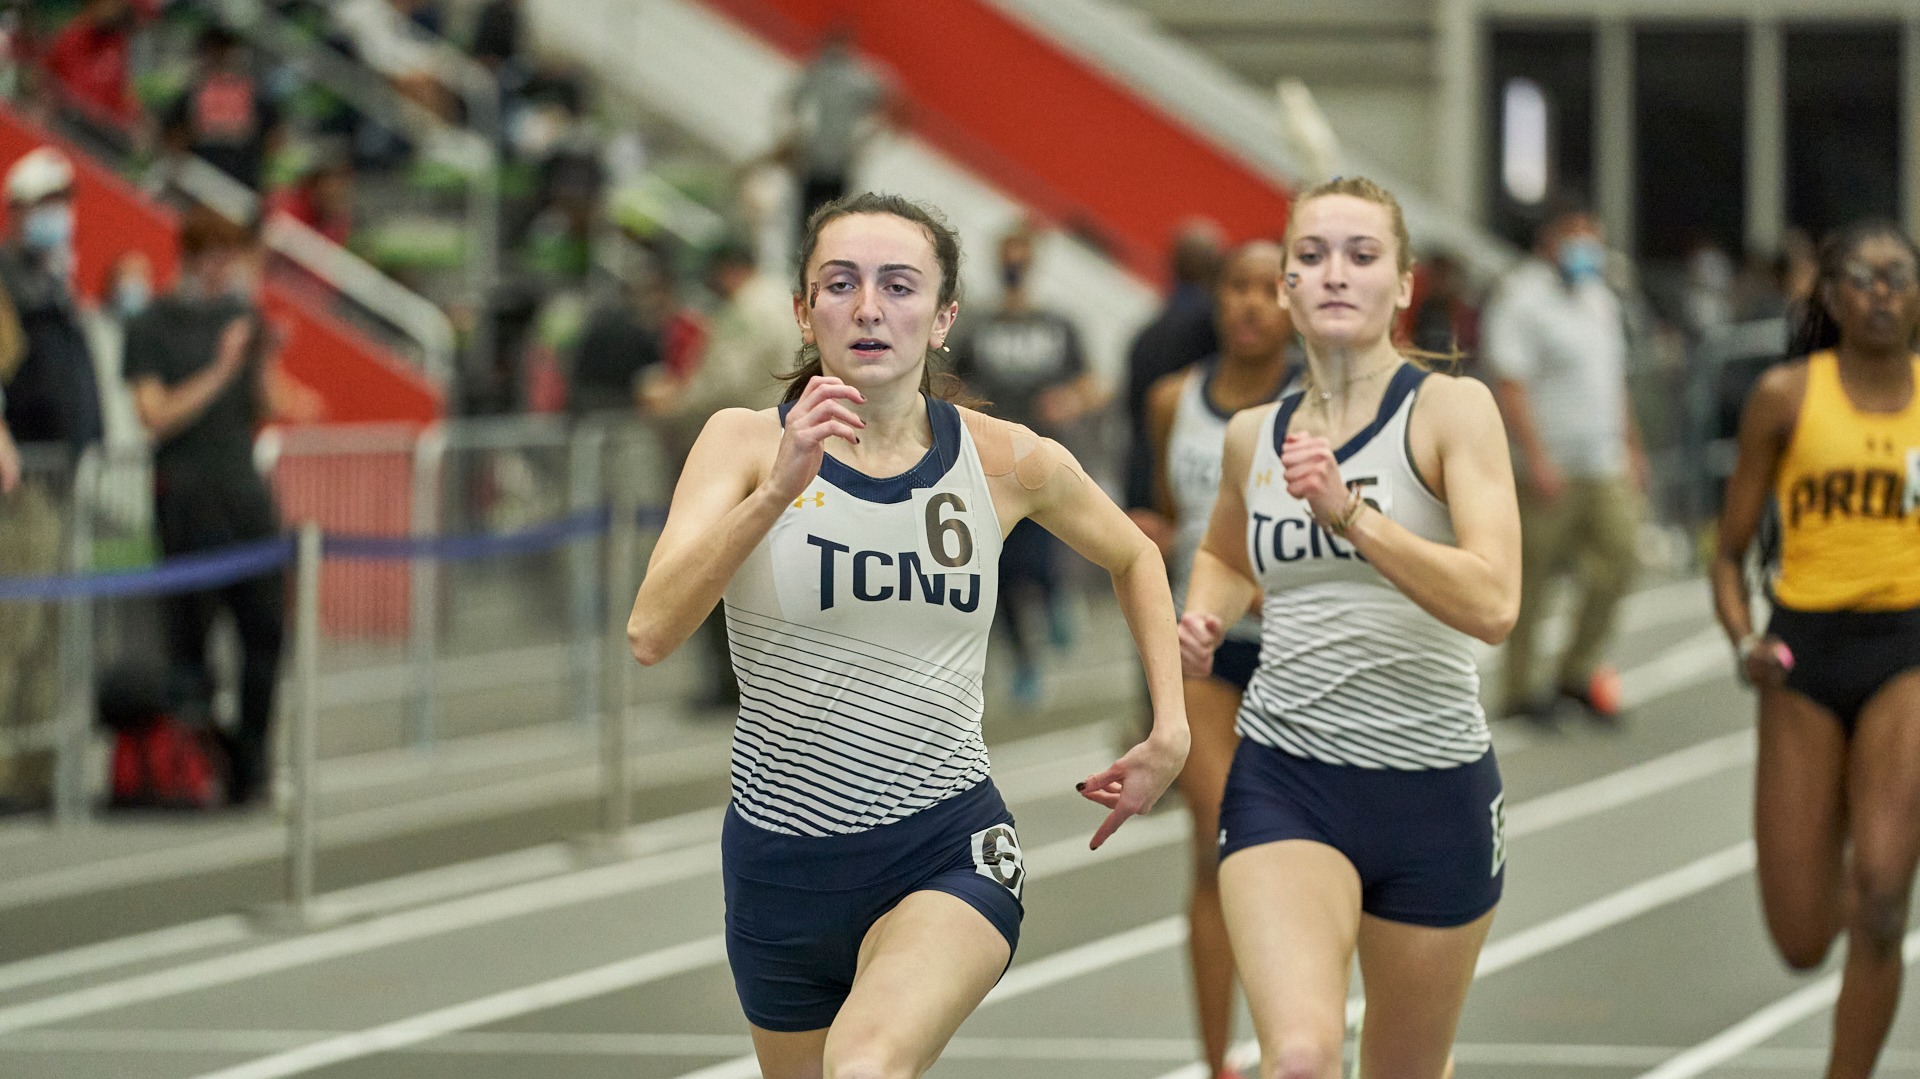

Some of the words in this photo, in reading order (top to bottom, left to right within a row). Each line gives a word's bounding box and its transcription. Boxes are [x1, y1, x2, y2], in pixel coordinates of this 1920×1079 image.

[925, 492, 973, 568] 6
[1253, 511, 1370, 575] TCN
[807, 533, 981, 613] TCNJ
[982, 827, 1022, 890] 6
